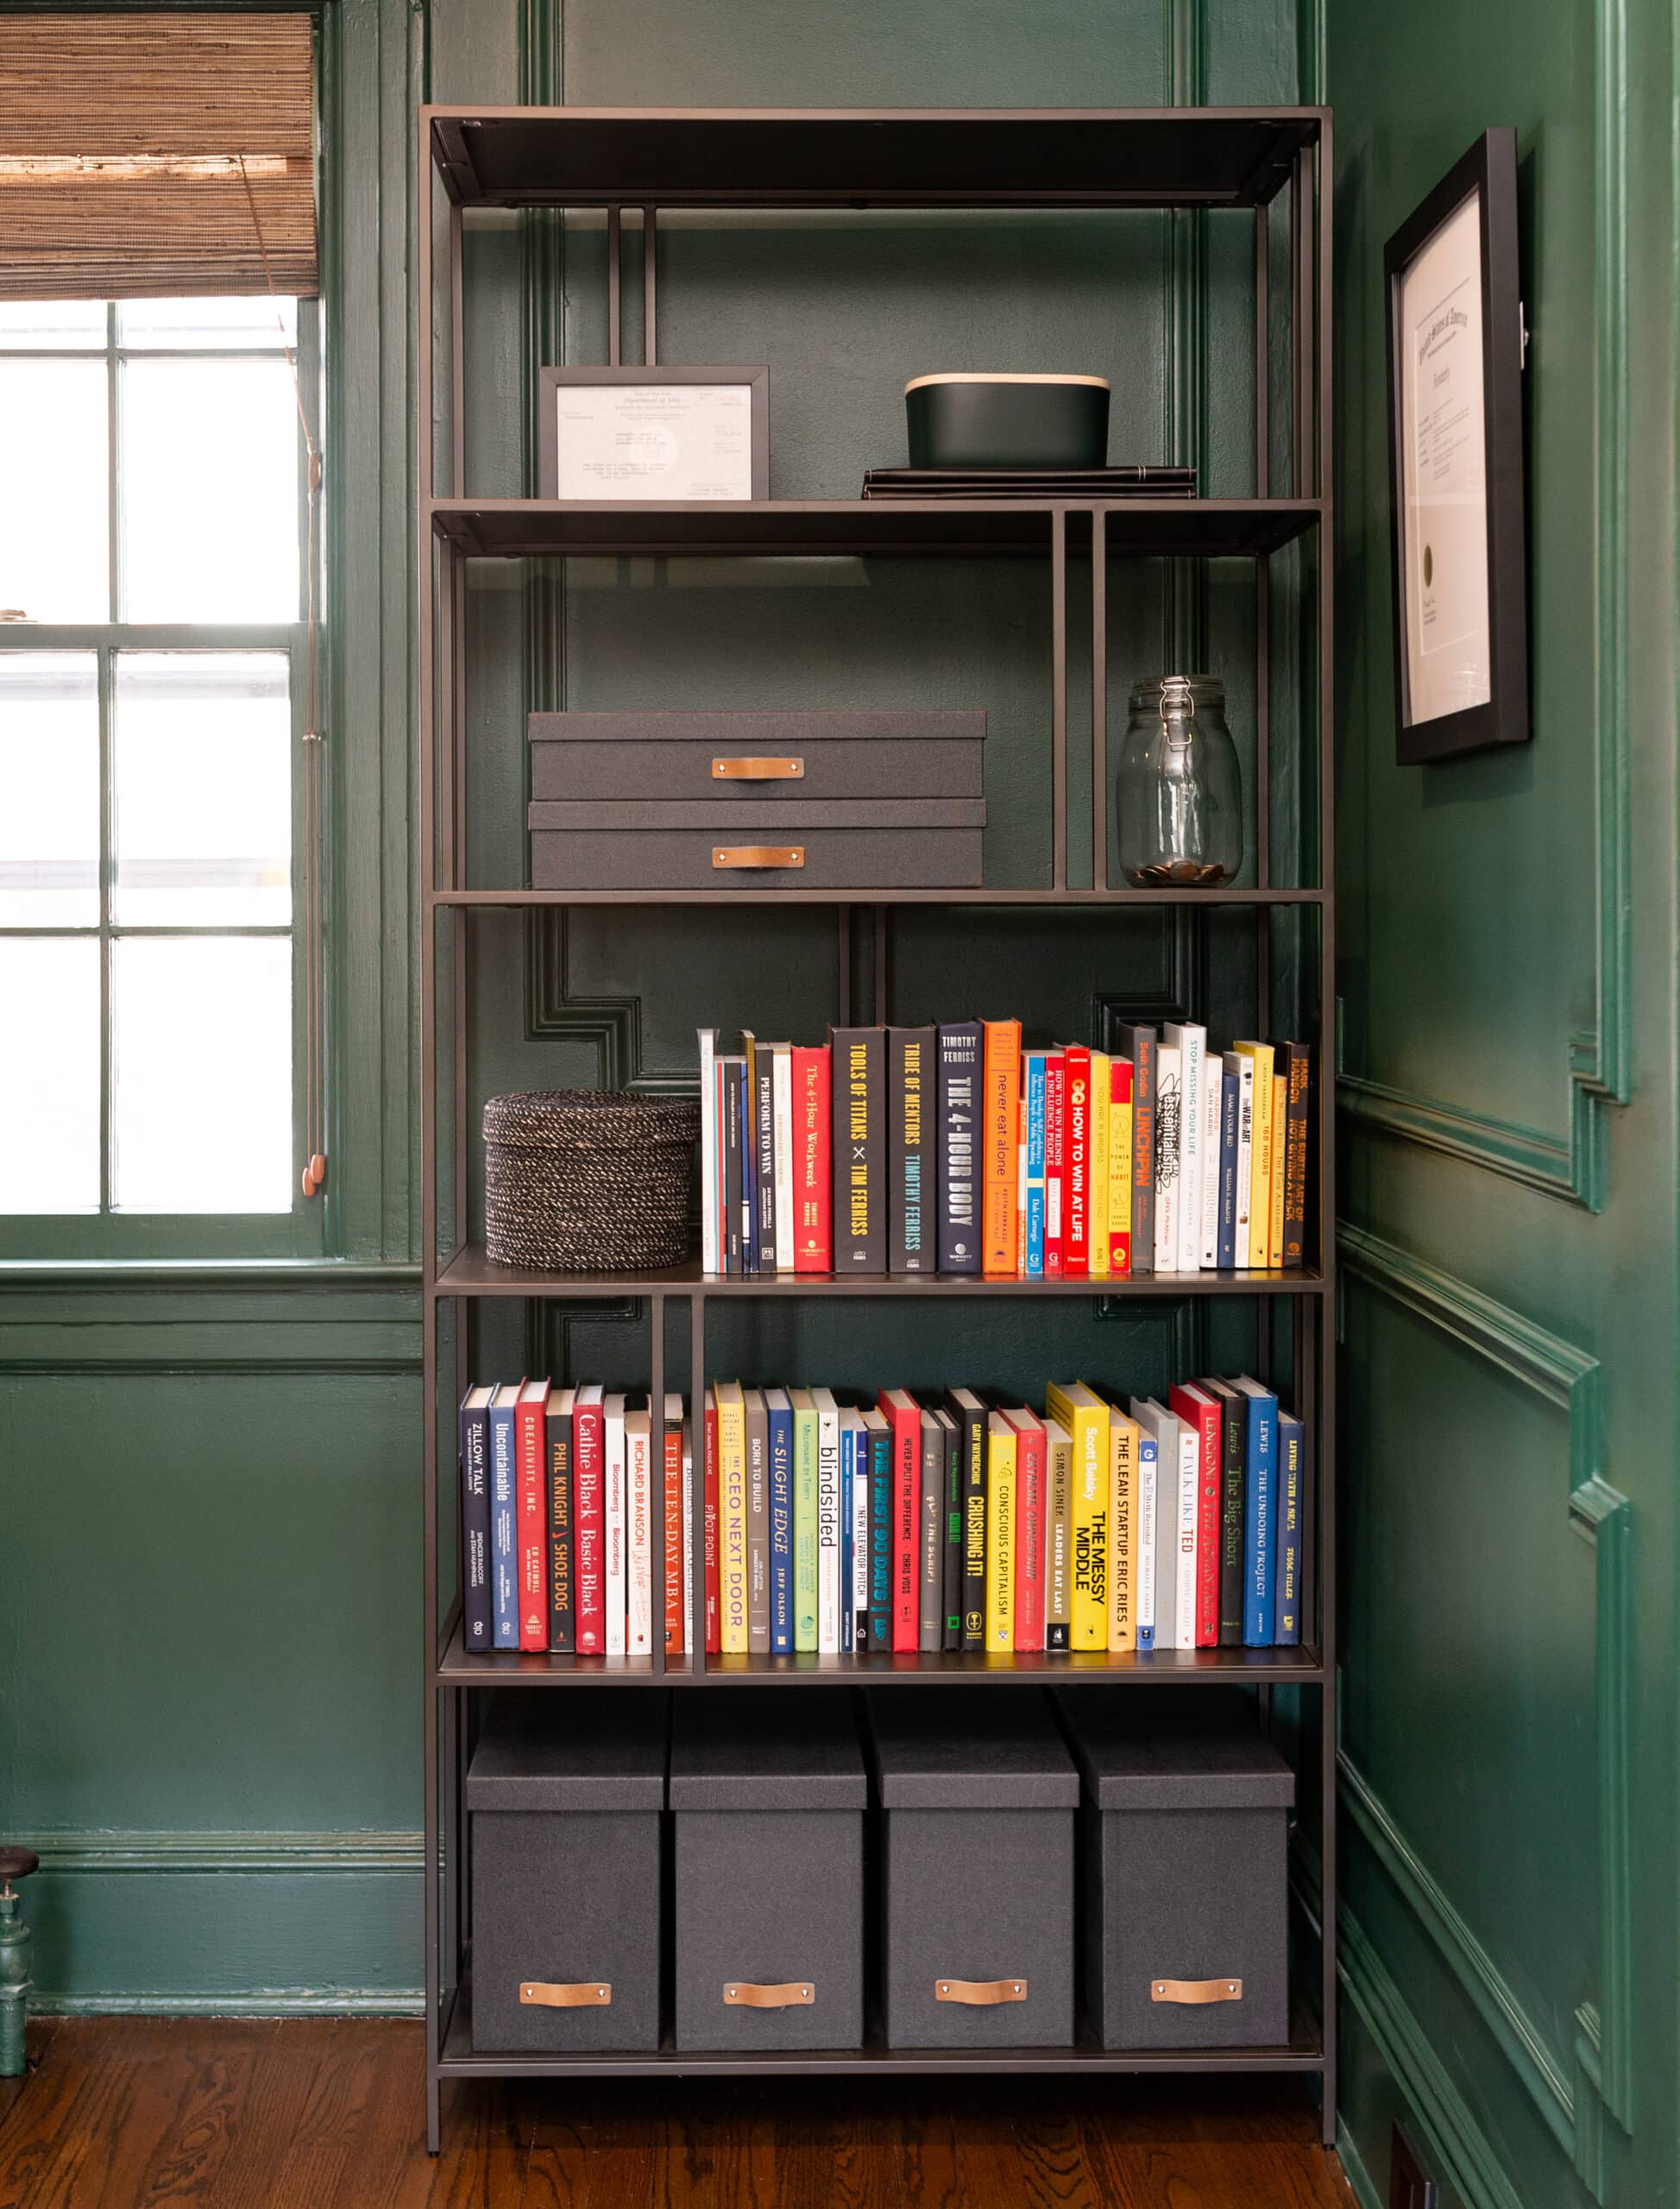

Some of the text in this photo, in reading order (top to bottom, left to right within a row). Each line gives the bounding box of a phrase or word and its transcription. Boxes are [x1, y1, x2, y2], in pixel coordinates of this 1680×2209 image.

[942, 1036, 976, 1048] TIMOTHY
[944, 1051, 975, 1062] FERRISS
[1139, 1042, 1148, 1098] Seth Godin
[1189, 1041, 1198, 1063] STOP
[1291, 1059, 1299, 1103] MANSON
[761, 1077, 771, 1174] PERFORM TO WIN
[807, 1066, 818, 1187] The 4-Hour Workweek
[997, 1075, 1010, 1176] never eat alone
[1054, 1091, 1062, 1104] TO
[1162, 1096, 1173, 1174] essentialism
[850, 1044, 867, 1236] TOOLS OF TITANS TIM FERRISS
[904, 1043, 920, 1250] TRIBE OF MENTORS TIMOTHY FERRISS
[948, 1077, 972, 1226] THE 4-HOUR BODY
[1071, 1079, 1085, 1242] GQ HOW TO WIN AT LIFE
[1136, 1108, 1150, 1186] LINCHPIN
[1187, 1137, 1196, 1155] LIFE
[1289, 1143, 1298, 1179] GIVING
[1295, 1119, 1306, 1222] THE SUBTLE ART OF
[1030, 1215, 1039, 1243] Carnegie
[473, 1424, 483, 1495] ZILLOW TALK
[495, 1424, 509, 1501] Uncontainable
[525, 1417, 536, 1517] CREATIVITY, INC.
[666, 1443, 677, 1481] THE
[752, 1438, 761, 1513] BORN TO BUILD
[775, 1448, 787, 1503] SLIGHT
[971, 1424, 981, 1484] GARY VAYNERCHUK
[1083, 1427, 1098, 1500] Scott Belsky
[1205, 1417, 1217, 1481] LENCIONI
[1230, 1422, 1241, 1453] Lewis
[1260, 1420, 1268, 1453] LEWIS
[1289, 1439, 1298, 1470] LIVING
[580, 1413, 596, 1615] Cathie Black Basic Black
[634, 1441, 644, 1546] RICHARD BRANSON
[820, 1447, 837, 1548] blindsided
[903, 1438, 911, 1540] NEVER SPLIT THE DIFFERENCE
[1027, 1452, 1037, 1505] EXTREME
[1056, 1452, 1065, 1517] SIMON SINEK
[1182, 1455, 1193, 1553] TALK LIKE TED
[1224, 1467, 1242, 1567] The Big Short
[554, 1443, 568, 1610] PHIL KNIGHT SHOE DOG
[611, 1463, 621, 1576] Bloomberg Bloomberg
[666, 1486, 678, 1565] TEN-DAY
[705, 1505, 714, 1567] PIVOT POINT
[729, 1472, 742, 1627] CEO NEXT DOOR
[775, 1507, 787, 1554] EDGE
[874, 1440, 889, 1602] THE FIRST 90 DAYS
[966, 1496, 984, 1577] CRUSHING IT!
[999, 1486, 1009, 1615] CONSCIOUS CAPITALISM
[1077, 1527, 1090, 1590] MIDDLE
[1092, 1512, 1105, 1605] THE MESSY
[1117, 1436, 1129, 1622] THE LEAN STARTUP ERIC RIES
[1255, 1470, 1268, 1597] THE UNDOING PROJECT
[667, 1571, 678, 1610] MBA
[903, 1553, 911, 1595] CHRIS VOSS
[1054, 1524, 1063, 1614] LEADERS EAT LAST
[1203, 1536, 1215, 1617] ADVANTAGE
